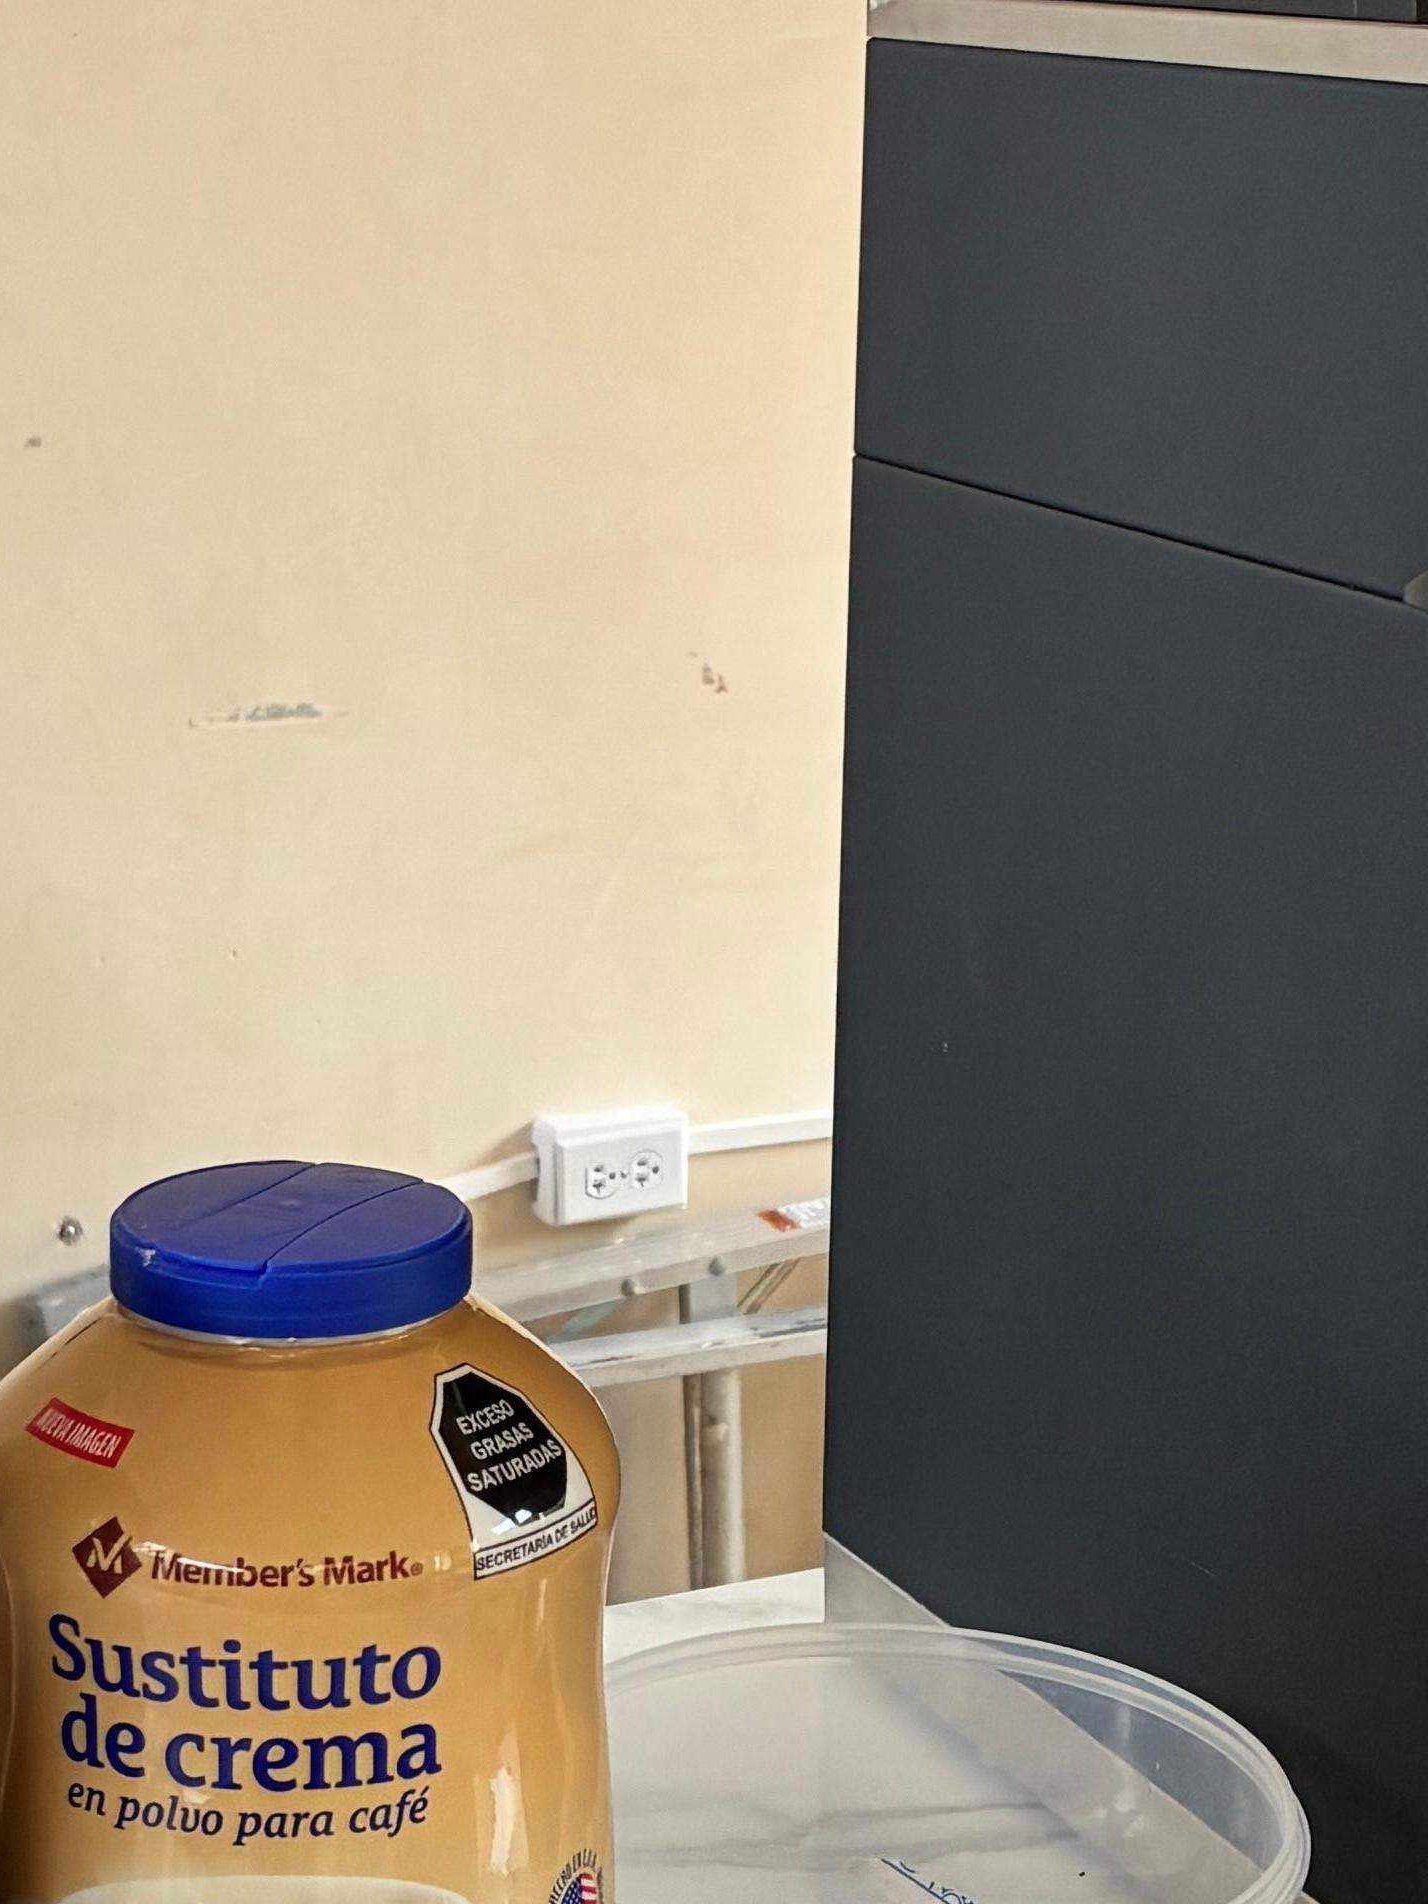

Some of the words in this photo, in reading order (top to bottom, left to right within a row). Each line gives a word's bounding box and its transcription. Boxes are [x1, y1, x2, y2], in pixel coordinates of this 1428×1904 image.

[38, 1406, 75, 1447] NUEVA
[70, 1419, 122, 1460] IMAGEN
[455, 1399, 515, 1436] EXCESO
[470, 1421, 535, 1460] GRASAS
[467, 1438, 563, 1493] SATURADAS
[151, 1549, 315, 1588] Member's
[323, 1550, 410, 1587] Mark
[475, 1535, 553, 1572] SECRETARÍA
[555, 1525, 570, 1544] DE
[48, 1614, 442, 1712] Sustituto
[61, 1692, 146, 1778] de
[164, 1722, 443, 1793] crema
[67, 1782, 107, 1817] en
[114, 1791, 224, 1837] polvo
[233, 1809, 335, 1847] para
[348, 1785, 431, 1838] café
